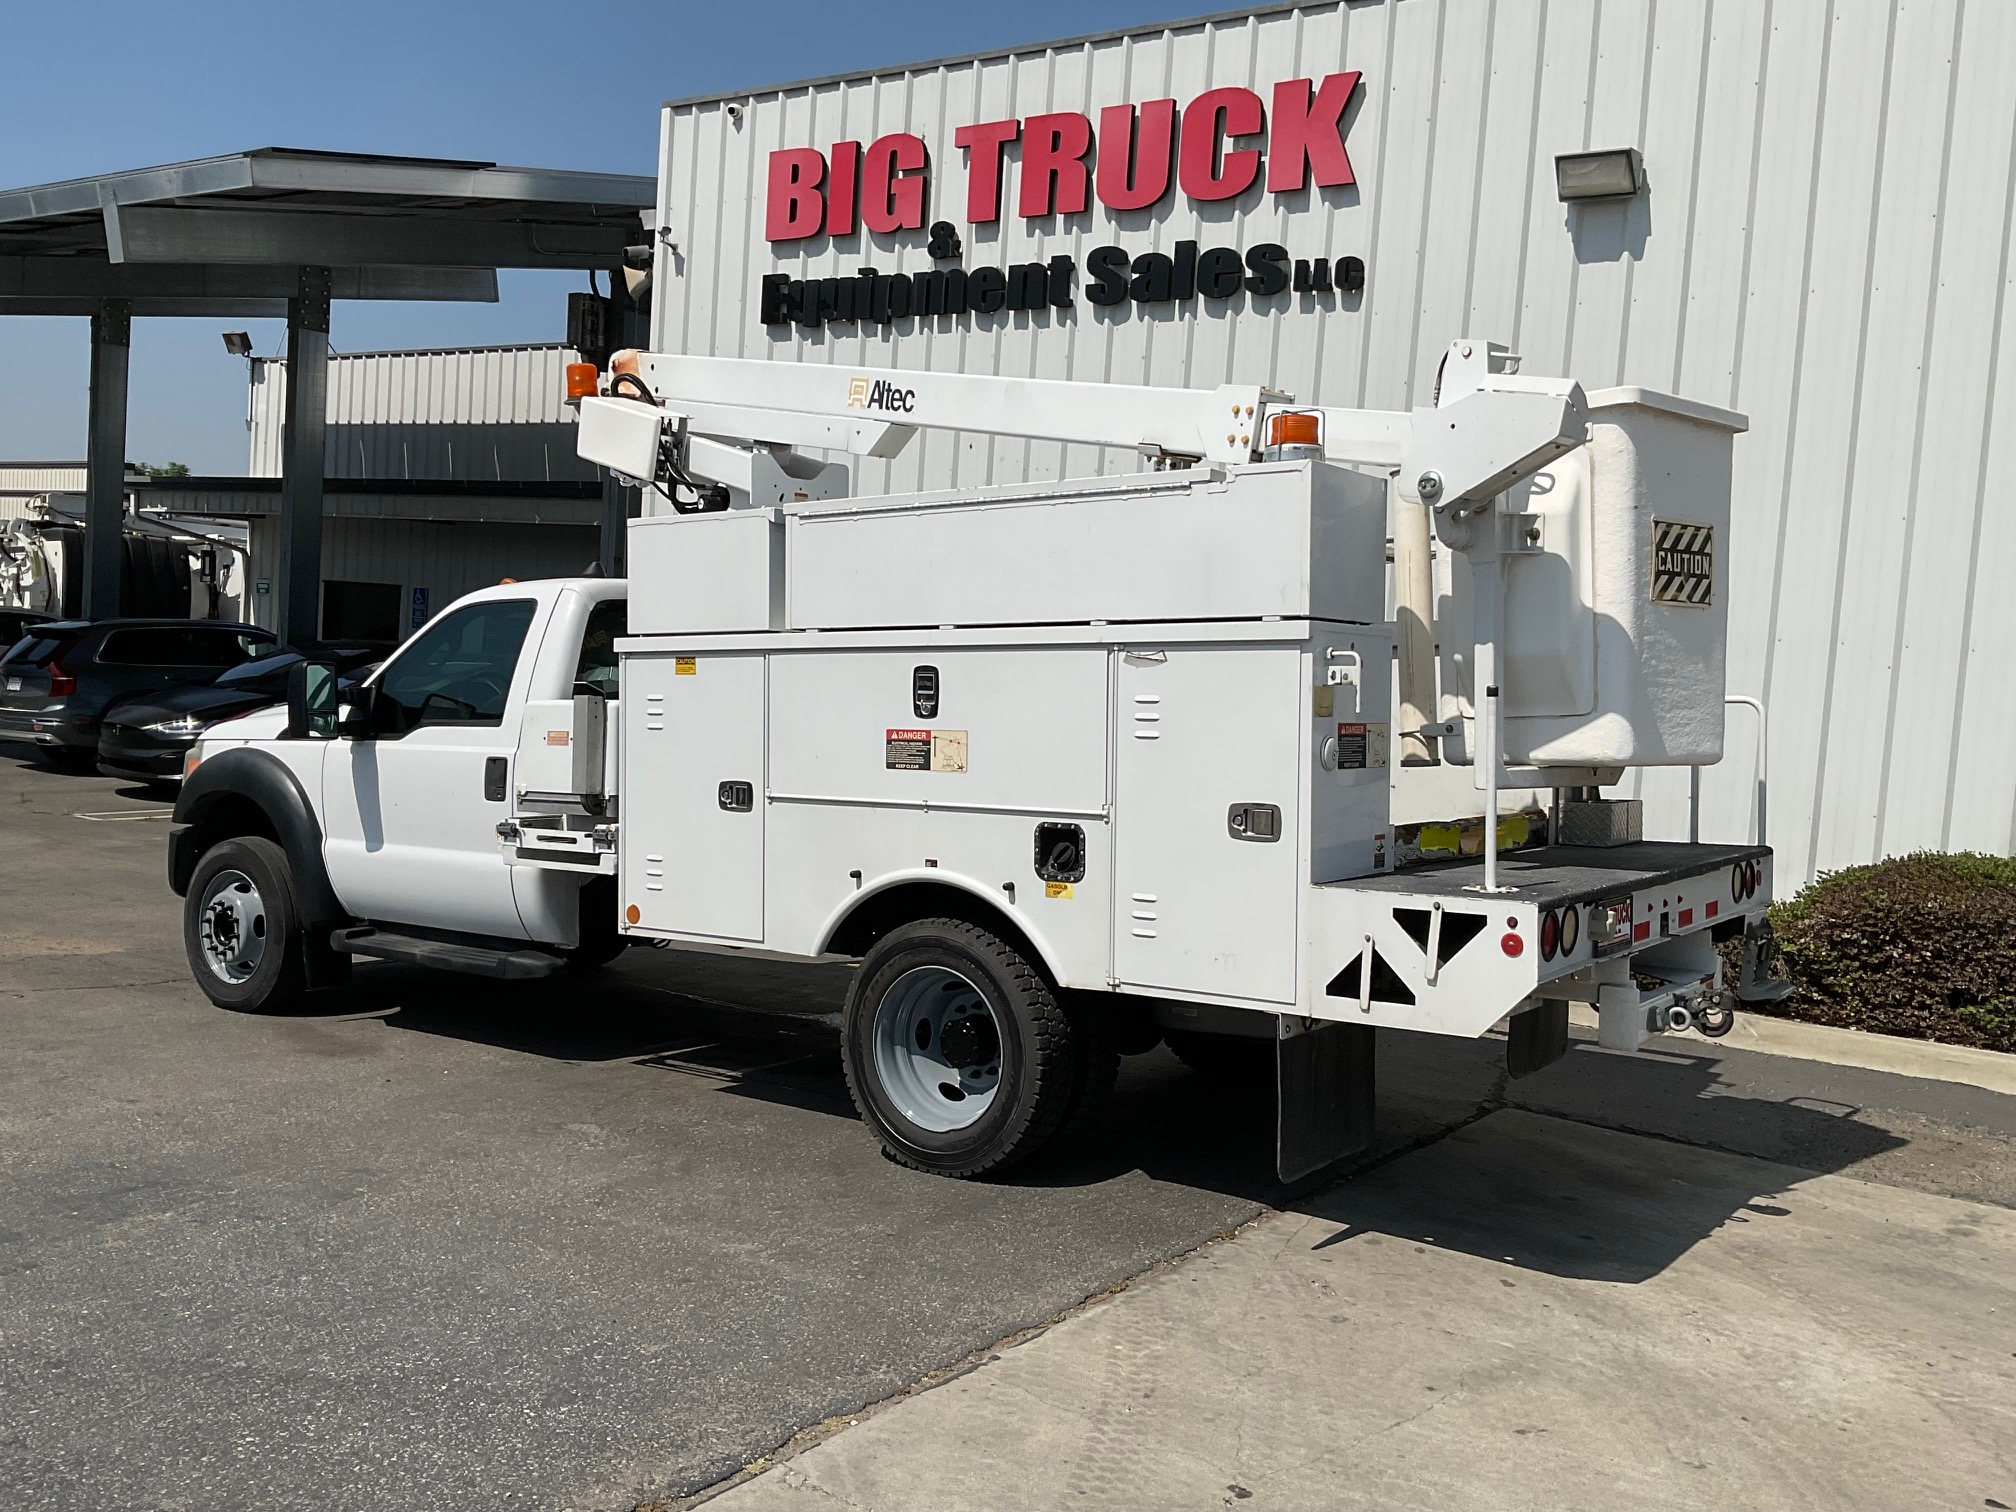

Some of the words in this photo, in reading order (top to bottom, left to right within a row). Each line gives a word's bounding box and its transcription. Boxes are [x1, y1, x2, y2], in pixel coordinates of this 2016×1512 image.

[766, 132, 929, 242] BIG
[955, 71, 1363, 223] TRUCK
[926, 221, 961, 259] &
[761, 255, 1075, 327] Equipment
[1085, 240, 1290, 306] Sales
[1293, 256, 1364, 292] LLC
[867, 380, 915, 412] Altec
[1658, 551, 1710, 575] CAUTION
[898, 731, 927, 740] DANGER
[1346, 725, 1364, 735] DANGER
